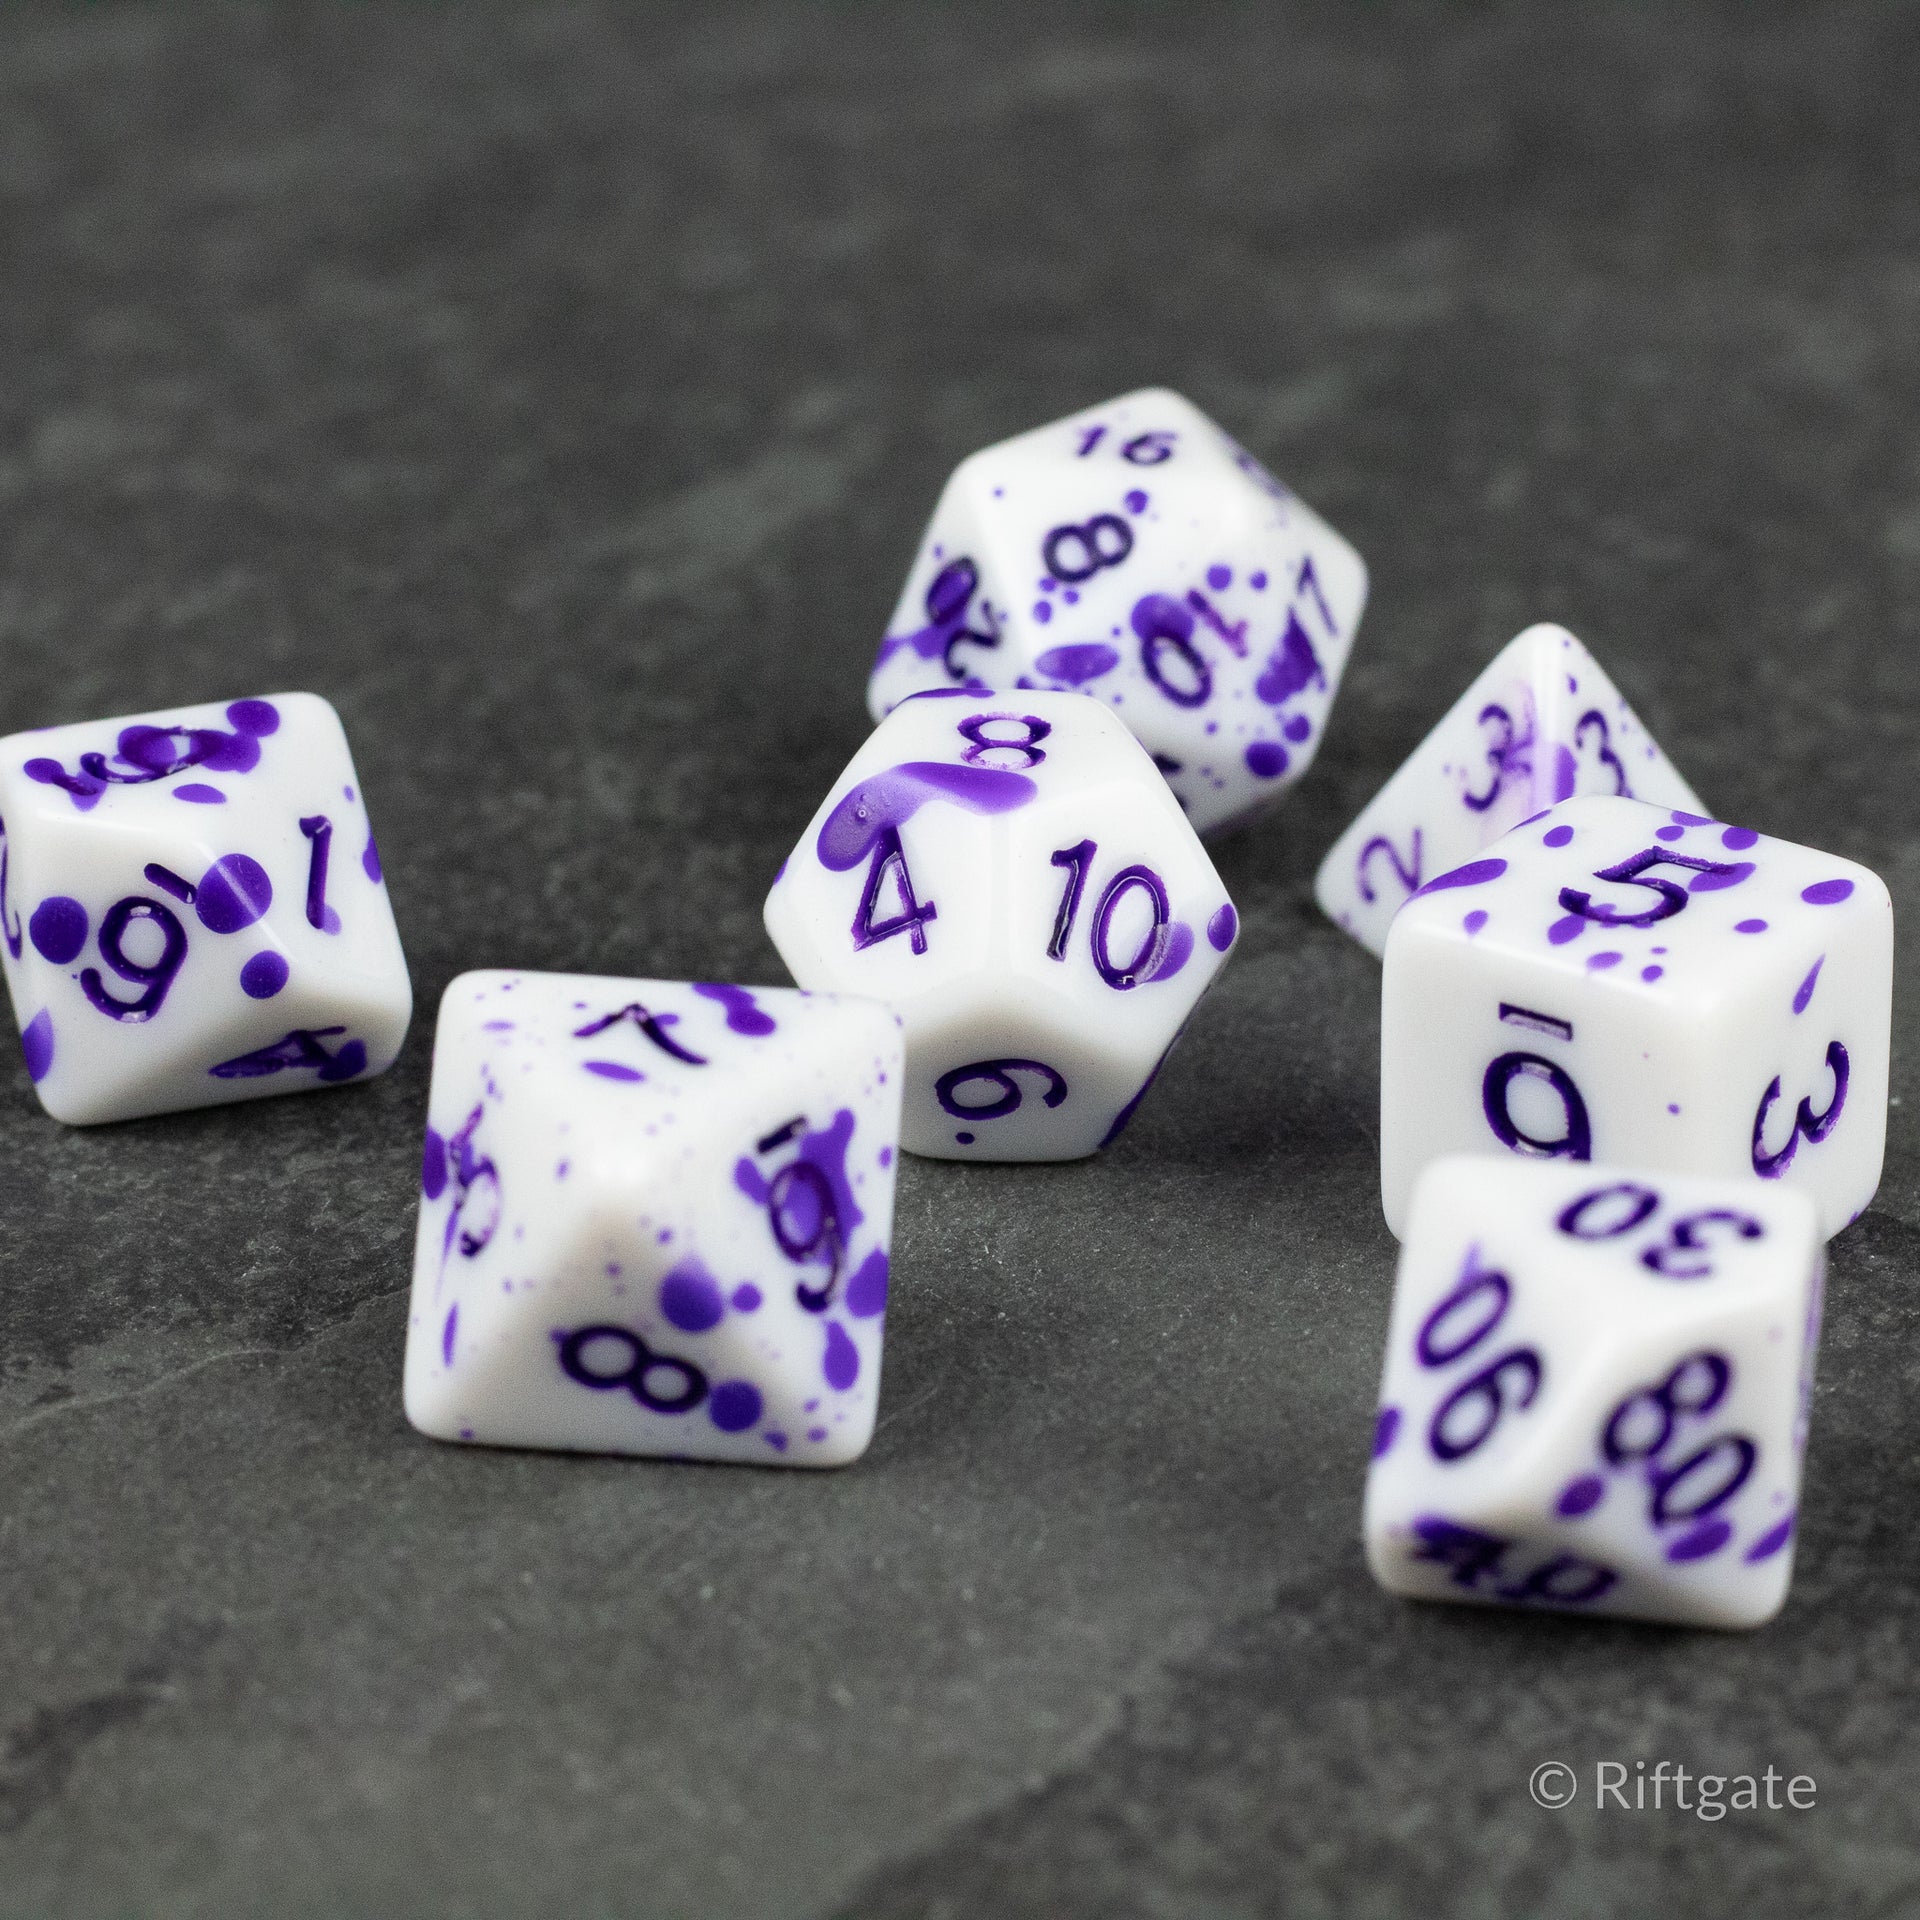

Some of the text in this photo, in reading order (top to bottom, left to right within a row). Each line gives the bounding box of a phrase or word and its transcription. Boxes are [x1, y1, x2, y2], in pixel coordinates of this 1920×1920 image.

[1079, 426, 1178, 466] 16
[1042, 514, 1133, 583] 8
[957, 711, 1051, 770] 8
[299, 815, 333, 929] 1
[852, 826, 938, 955] 4
[1046, 839, 1170, 991] 10
[1557, 845, 1738, 925] 5
[1752, 1040, 1850, 1180] 3
[558, 1325, 710, 1414] 8
[1602, 1349, 1757, 1529] 80
